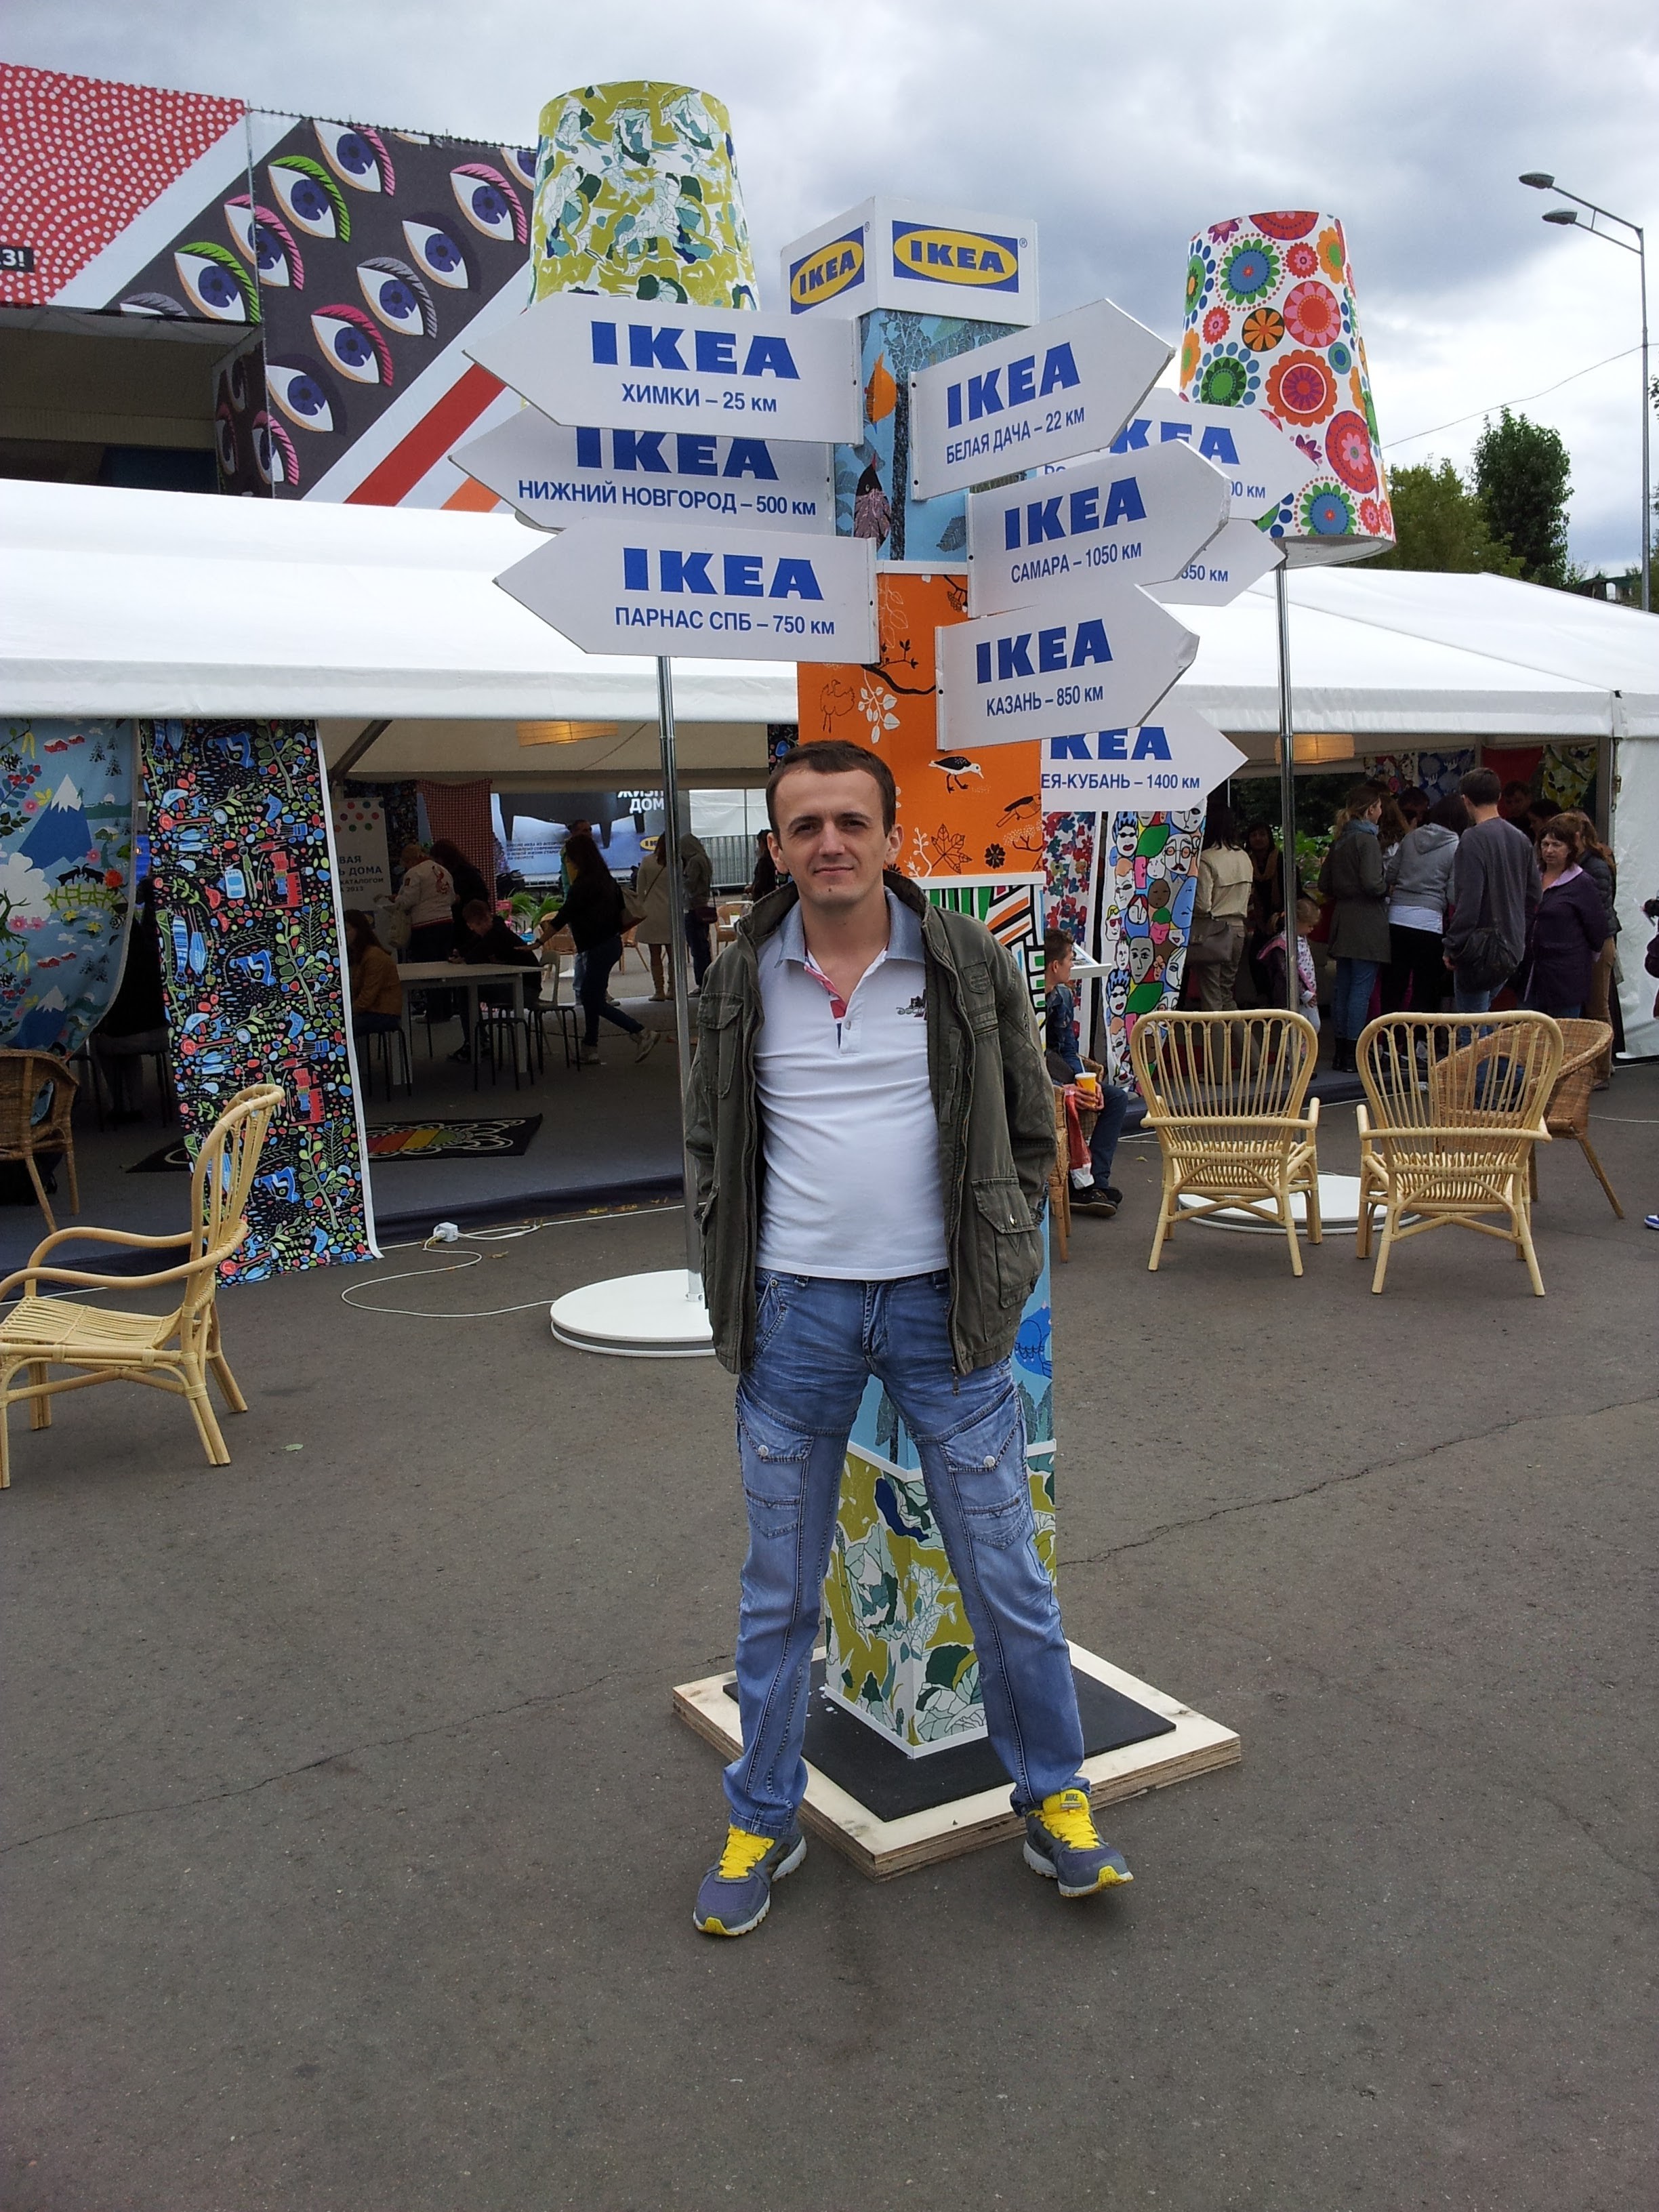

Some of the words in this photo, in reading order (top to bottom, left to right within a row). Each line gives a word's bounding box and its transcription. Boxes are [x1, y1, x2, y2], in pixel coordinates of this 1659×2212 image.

[0, 249, 25, 267] 3!
[800, 249, 856, 295] IKEA
[910, 240, 1005, 273] IKEA
[591, 321, 800, 380] IKEA
[621, 384, 700, 407] ХИМКИ
[723, 391, 745, 411] 25
[947, 342, 1081, 429] IKEA
[576, 428, 779, 481] IKEA
[947, 432, 989, 464] БЕЛАЯ
[993, 420, 1031, 453] ДАЧА
[1046, 410, 1062, 433] 22
[518, 480, 616, 504] НИЖНИЙ
[622, 487, 737, 514] НОВГОРОД
[756, 495, 787, 514] 500
[1005, 476, 1147, 550] IKEA
[623, 548, 823, 600] IKEA
[1011, 554, 1070, 583] САМАРА
[1086, 544, 1118, 567] 1050
[615, 607, 703, 630] ПАРНАС
[709, 611, 752, 632] СПБ
[773, 615, 805, 634] 750
[976, 618, 1113, 684] IKEA
[987, 691, 1042, 717] КАЗАНЬ
[1057, 684, 1080, 707] 850
[1147, 774, 1179, 789] 1400
[349, 866, 382, 876] ДОМА
